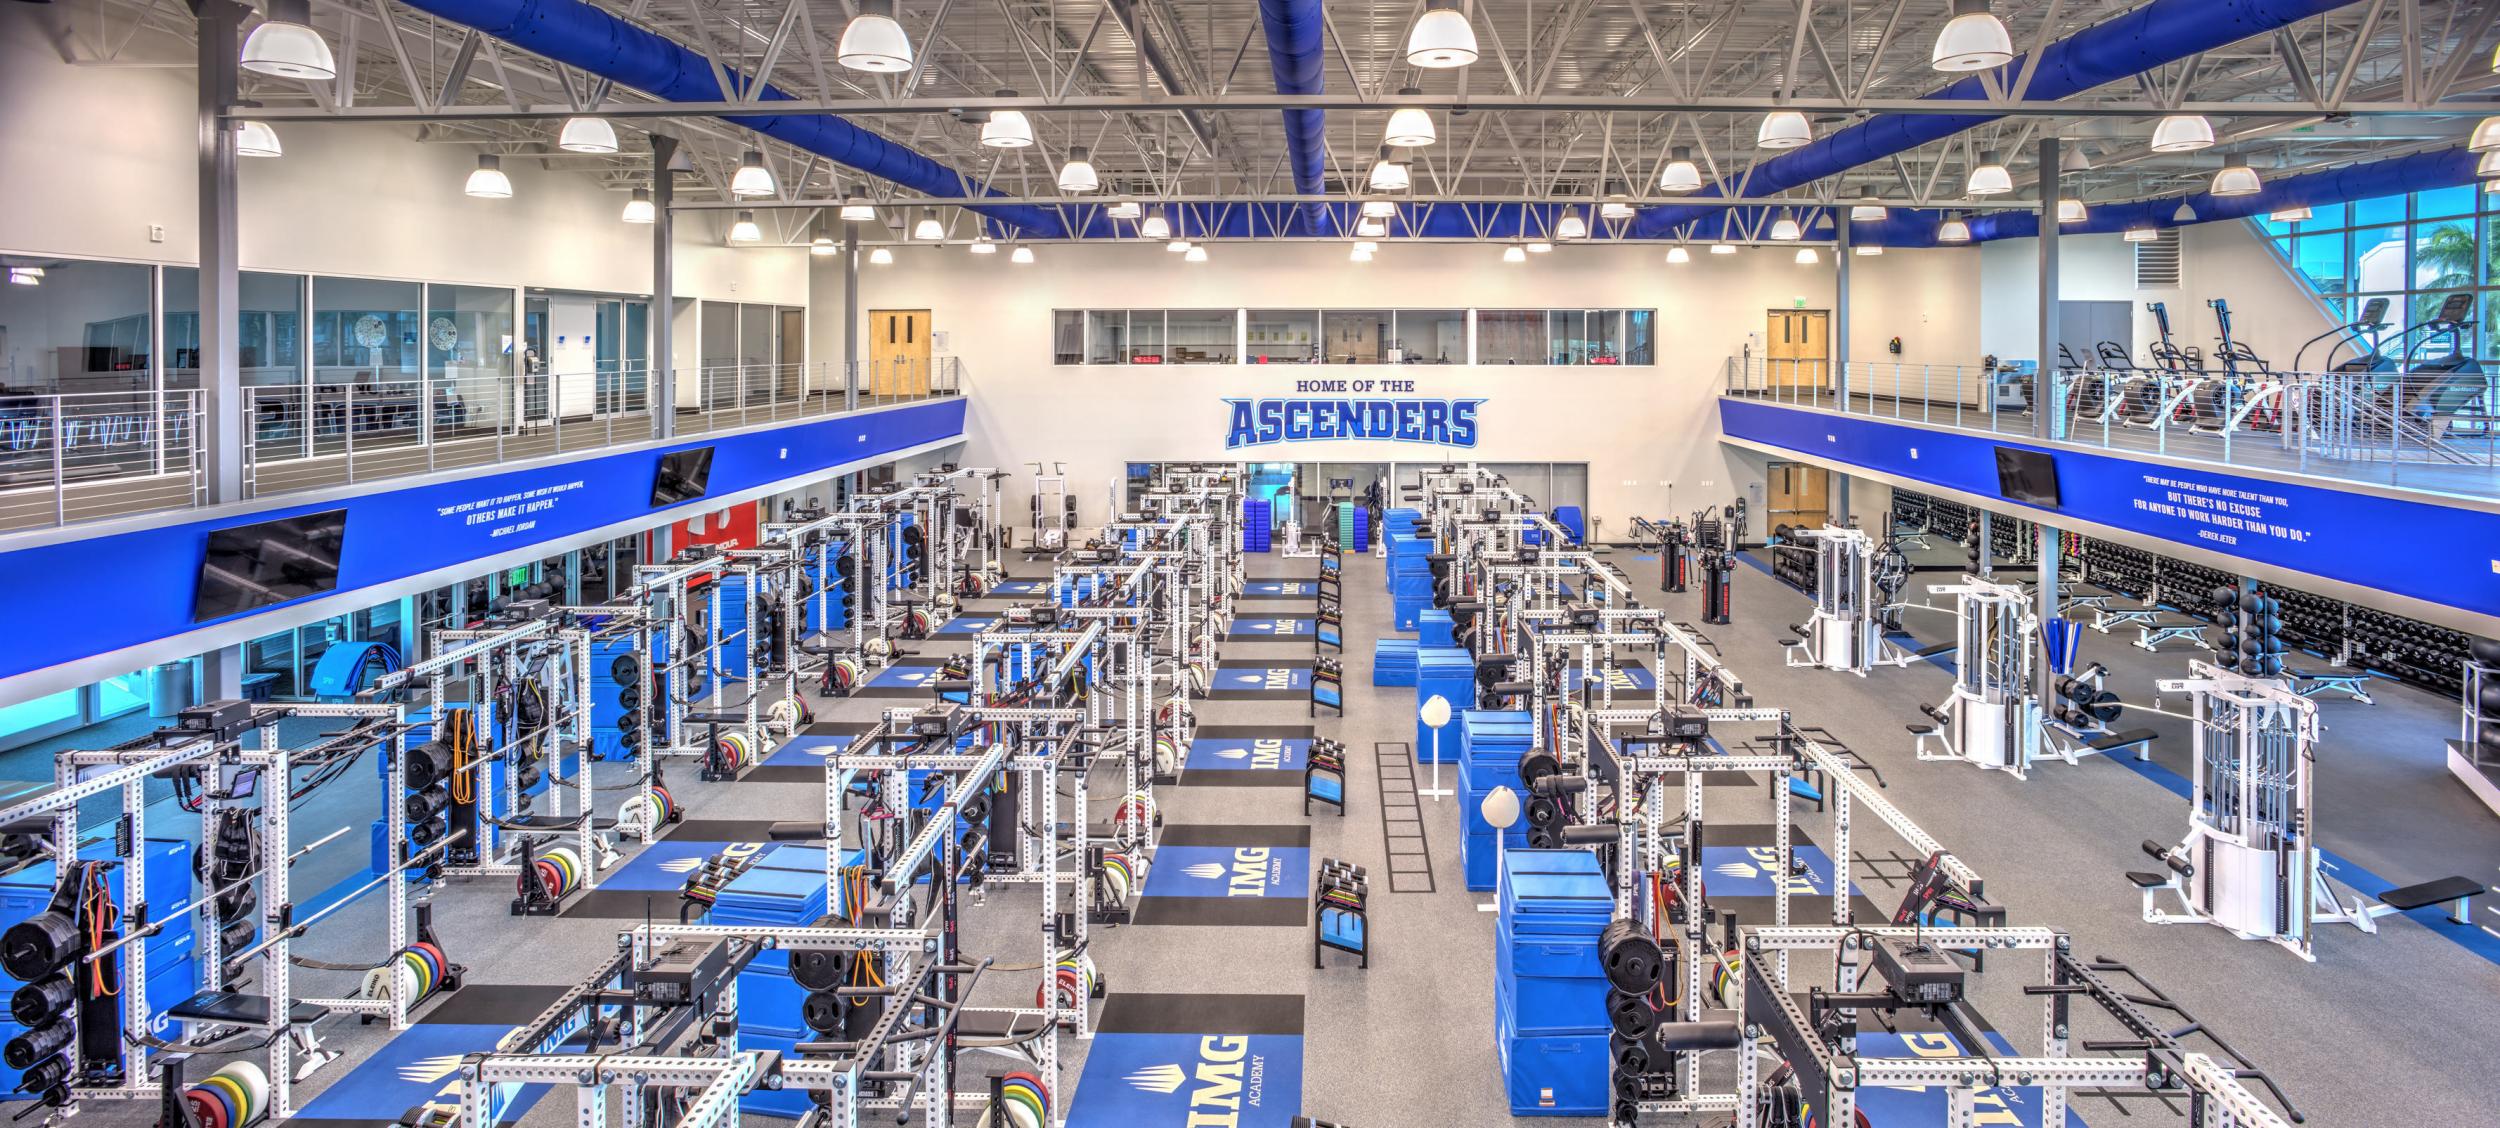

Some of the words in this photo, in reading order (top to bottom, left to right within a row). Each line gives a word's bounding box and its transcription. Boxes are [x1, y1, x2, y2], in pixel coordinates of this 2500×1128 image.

[1297, 380, 1347, 392] HOME
[1353, 380, 1374, 392] OF
[1380, 380, 1415, 392] THE
[1220, 398, 1490, 449] ASCENDERS
[456, 503, 474, 513] PEOPLE
[476, 499, 489, 509] WANT
[523, 491, 535, 499] SOME
[553, 485, 566, 493] WOULD
[2160, 478, 2169, 487] MAY
[2170, 480, 2177, 488] BE
[2178, 481, 2195, 491] PEOPLE
[2196, 484, 2207, 492] WHO
[2208, 486, 2221, 495] HAVE
[2222, 488, 2236, 498] MORE
[2238, 490, 2258, 501] TALENT
[2259, 494, 2273, 504] THAN
[2274, 497, 2288, 507] YOU,
[2168, 491, 2181, 502] BUT
[2182, 494, 2214, 509] THERE'S
[2216, 500, 2227, 511] NO
[2229, 502, 2261, 518] EXCUSE
[466, 510, 495, 526] OTHERS
[498, 506, 516, 519] MAKE
[518, 504, 525, 514] IT
[527, 498, 559, 513] HAPPEN."
[2134, 499, 2147, 510] FOR
[2149, 502, 2175, 516] ANYONE
[2177, 507, 2186, 518] TO
[2188, 509, 2210, 523] WORK
[2211, 513, 2243, 530] HARDER
[2245, 519, 2267, 535] THAN
[2269, 524, 2287, 538] YOU
[2290, 530, 2311, 542] DO."
[516, 520, 536, 532] JORDAN
[2220, 533, 2237, 545] JETER
[1275, 620, 1296, 634] IMG
[1265, 669, 1290, 689] IMG
[1251, 739, 1282, 769] IMG
[1228, 848, 1270, 896] IMG
[1272, 858, 1281, 885] ACADEMY
[368, 974, 380, 997] ELEIKO
[1059, 979, 1076, 993] ELEIK
[1186, 1035, 1248, 1128] IMG
[1249, 1055, 1264, 1106] ACADEMY
